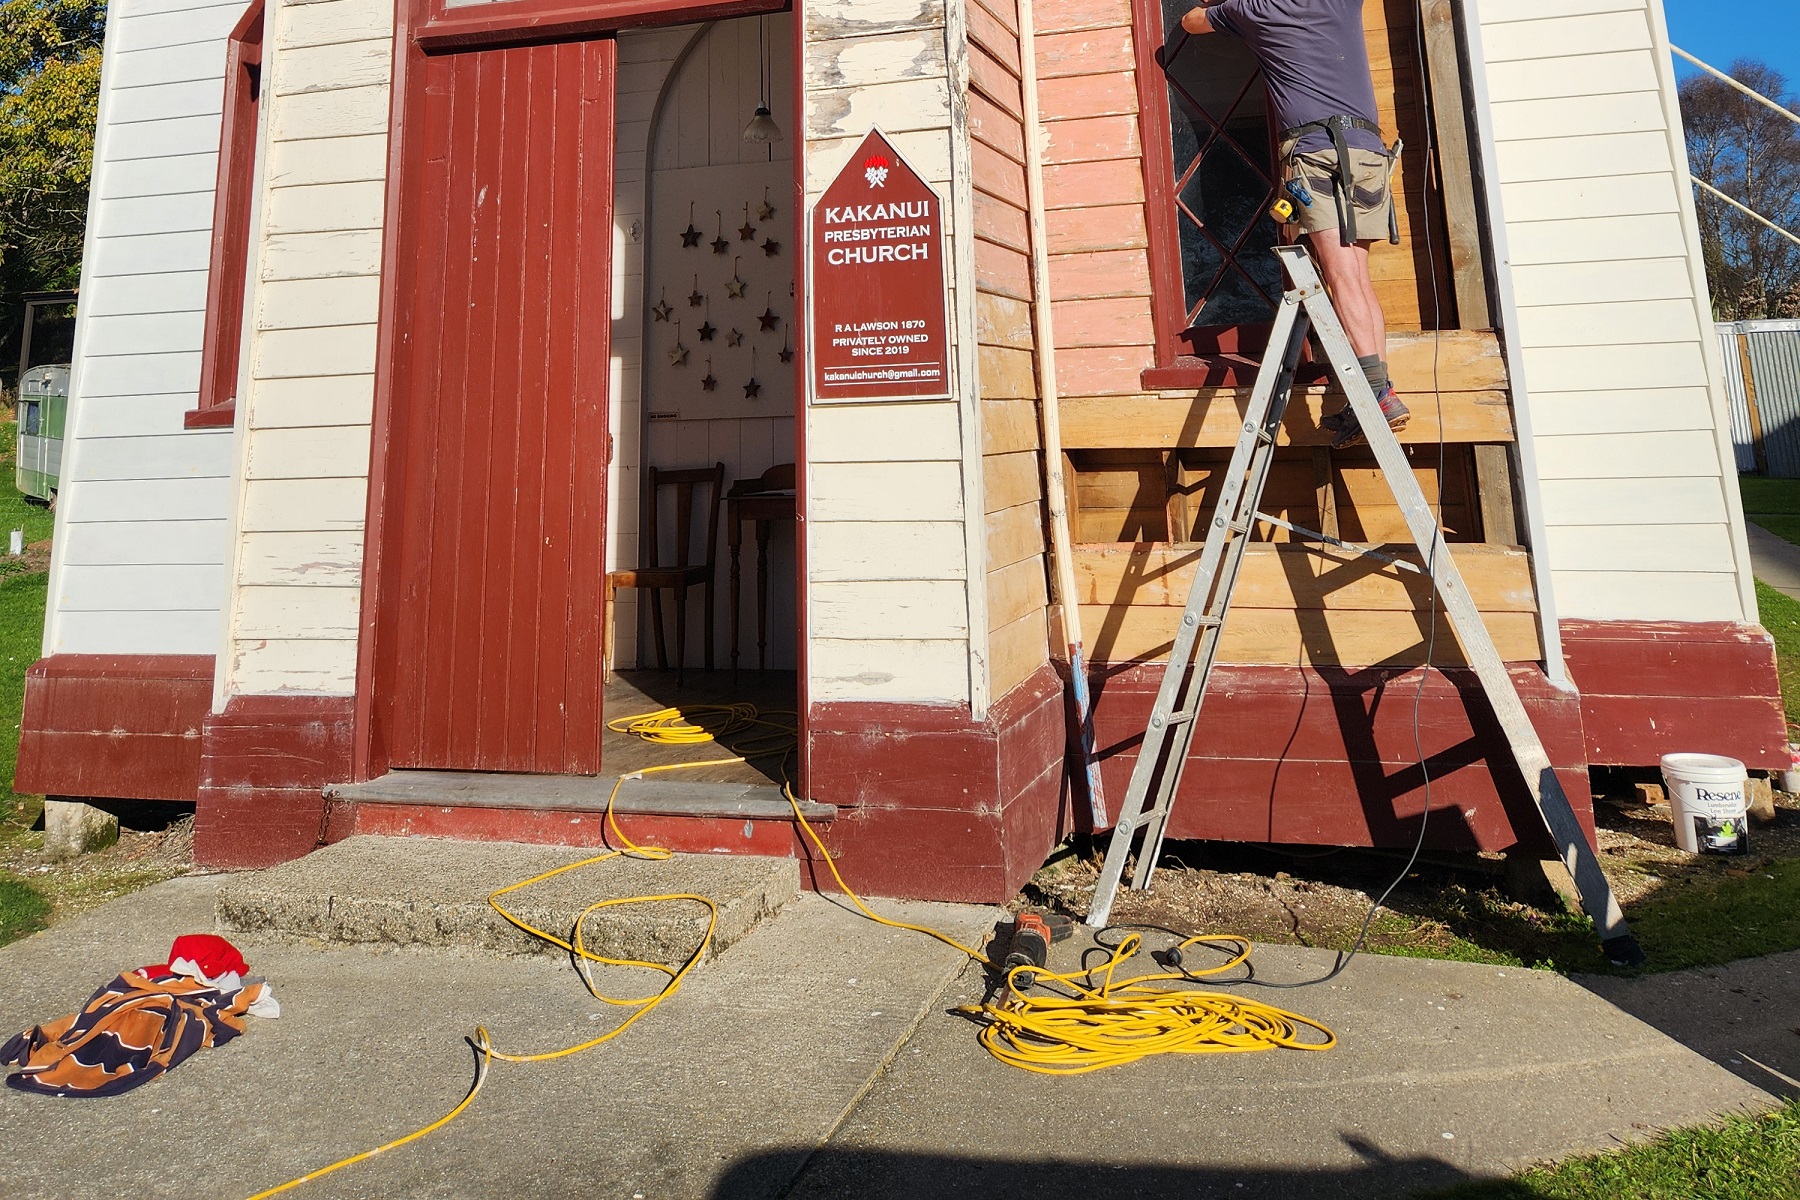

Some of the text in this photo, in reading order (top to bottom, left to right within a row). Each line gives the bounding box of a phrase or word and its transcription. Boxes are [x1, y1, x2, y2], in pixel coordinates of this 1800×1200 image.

[825, 200, 929, 224] KAKANUI
[824, 224, 930, 243] PRESBYTERIAN
[827, 243, 928, 265] CHURCH
[835, 320, 925, 332] R A LAWSON 1870
[832, 334, 929, 347] PRIVATELY OWNED
[851, 346, 910, 356] SINCE 2019
[824, 368, 940, 381] kakanuichurch@gmail.com
[1695, 787, 1741, 801] Resene
